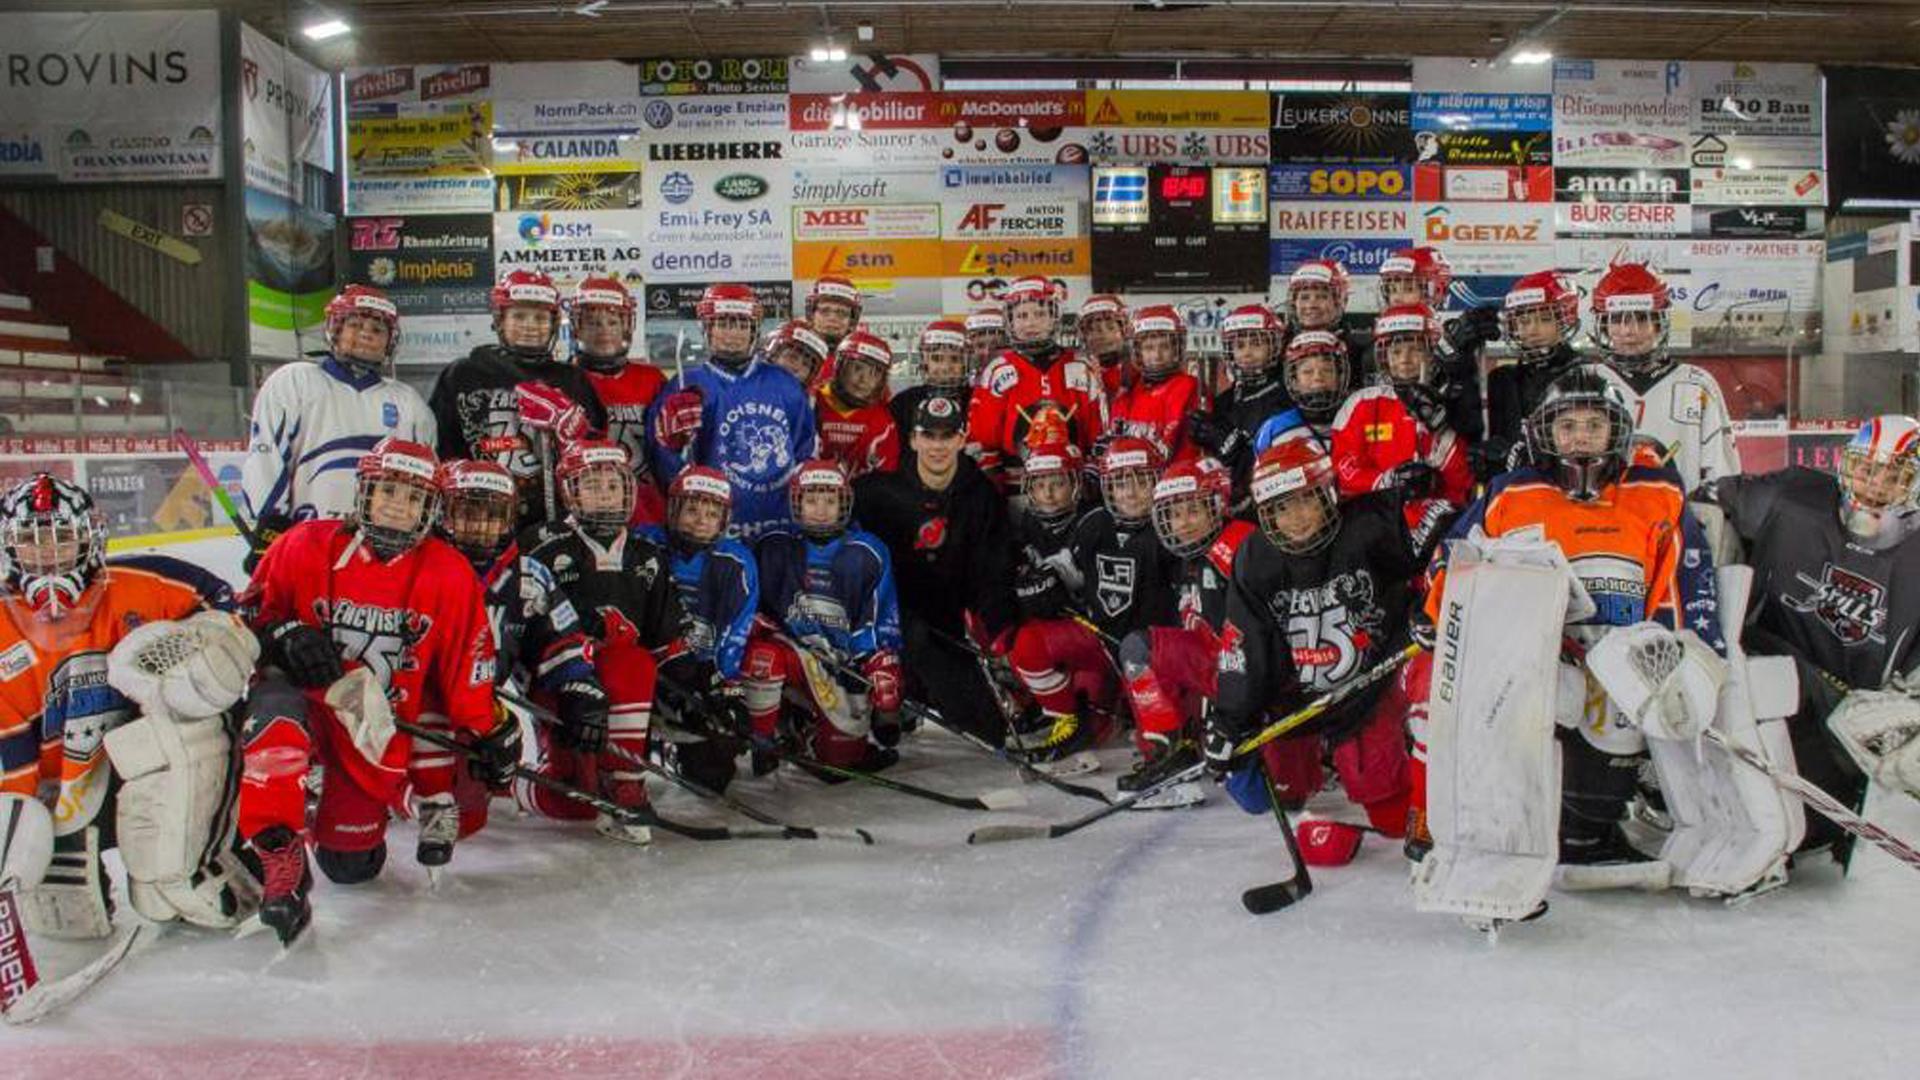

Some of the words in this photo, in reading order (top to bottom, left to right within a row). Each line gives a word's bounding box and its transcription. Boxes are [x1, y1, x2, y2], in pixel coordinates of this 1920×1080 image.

[534, 102, 638, 119] NormPack.ch
[678, 101, 732, 117] Garage
[803, 102, 831, 122] die
[842, 103, 925, 124] obiliar
[960, 99, 1064, 116] McDonald's
[1768, 100, 1811, 113] Bau
[532, 139, 619, 159] CALANDA
[791, 132, 852, 149] Garage
[1122, 134, 1177, 157] UBS
[1215, 134, 1268, 157] UBS
[650, 142, 783, 161] LIEBHERR
[791, 178, 888, 202] simplysoft
[1309, 169, 1405, 195] SOPO
[1025, 204, 1065, 215] ANTON
[1570, 204, 1676, 223] BURGENER
[703, 210, 743, 229] Frey
[747, 209, 773, 226] SA
[1000, 217, 1065, 230] FERCHER
[1278, 210, 1407, 231] RAIFFEISEN
[552, 222, 592, 237] DSM
[1453, 224, 1540, 241] GETAZ
[499, 249, 607, 263] AMMETER
[612, 246, 641, 261] AG
[845, 249, 895, 267] stm
[1746, 243, 1800, 256] PARTNER
[651, 250, 733, 270] dennda
[398, 258, 475, 283] Implenia
[91, 477, 146, 493] FRANZEN
[1100, 560, 1131, 584] LA
